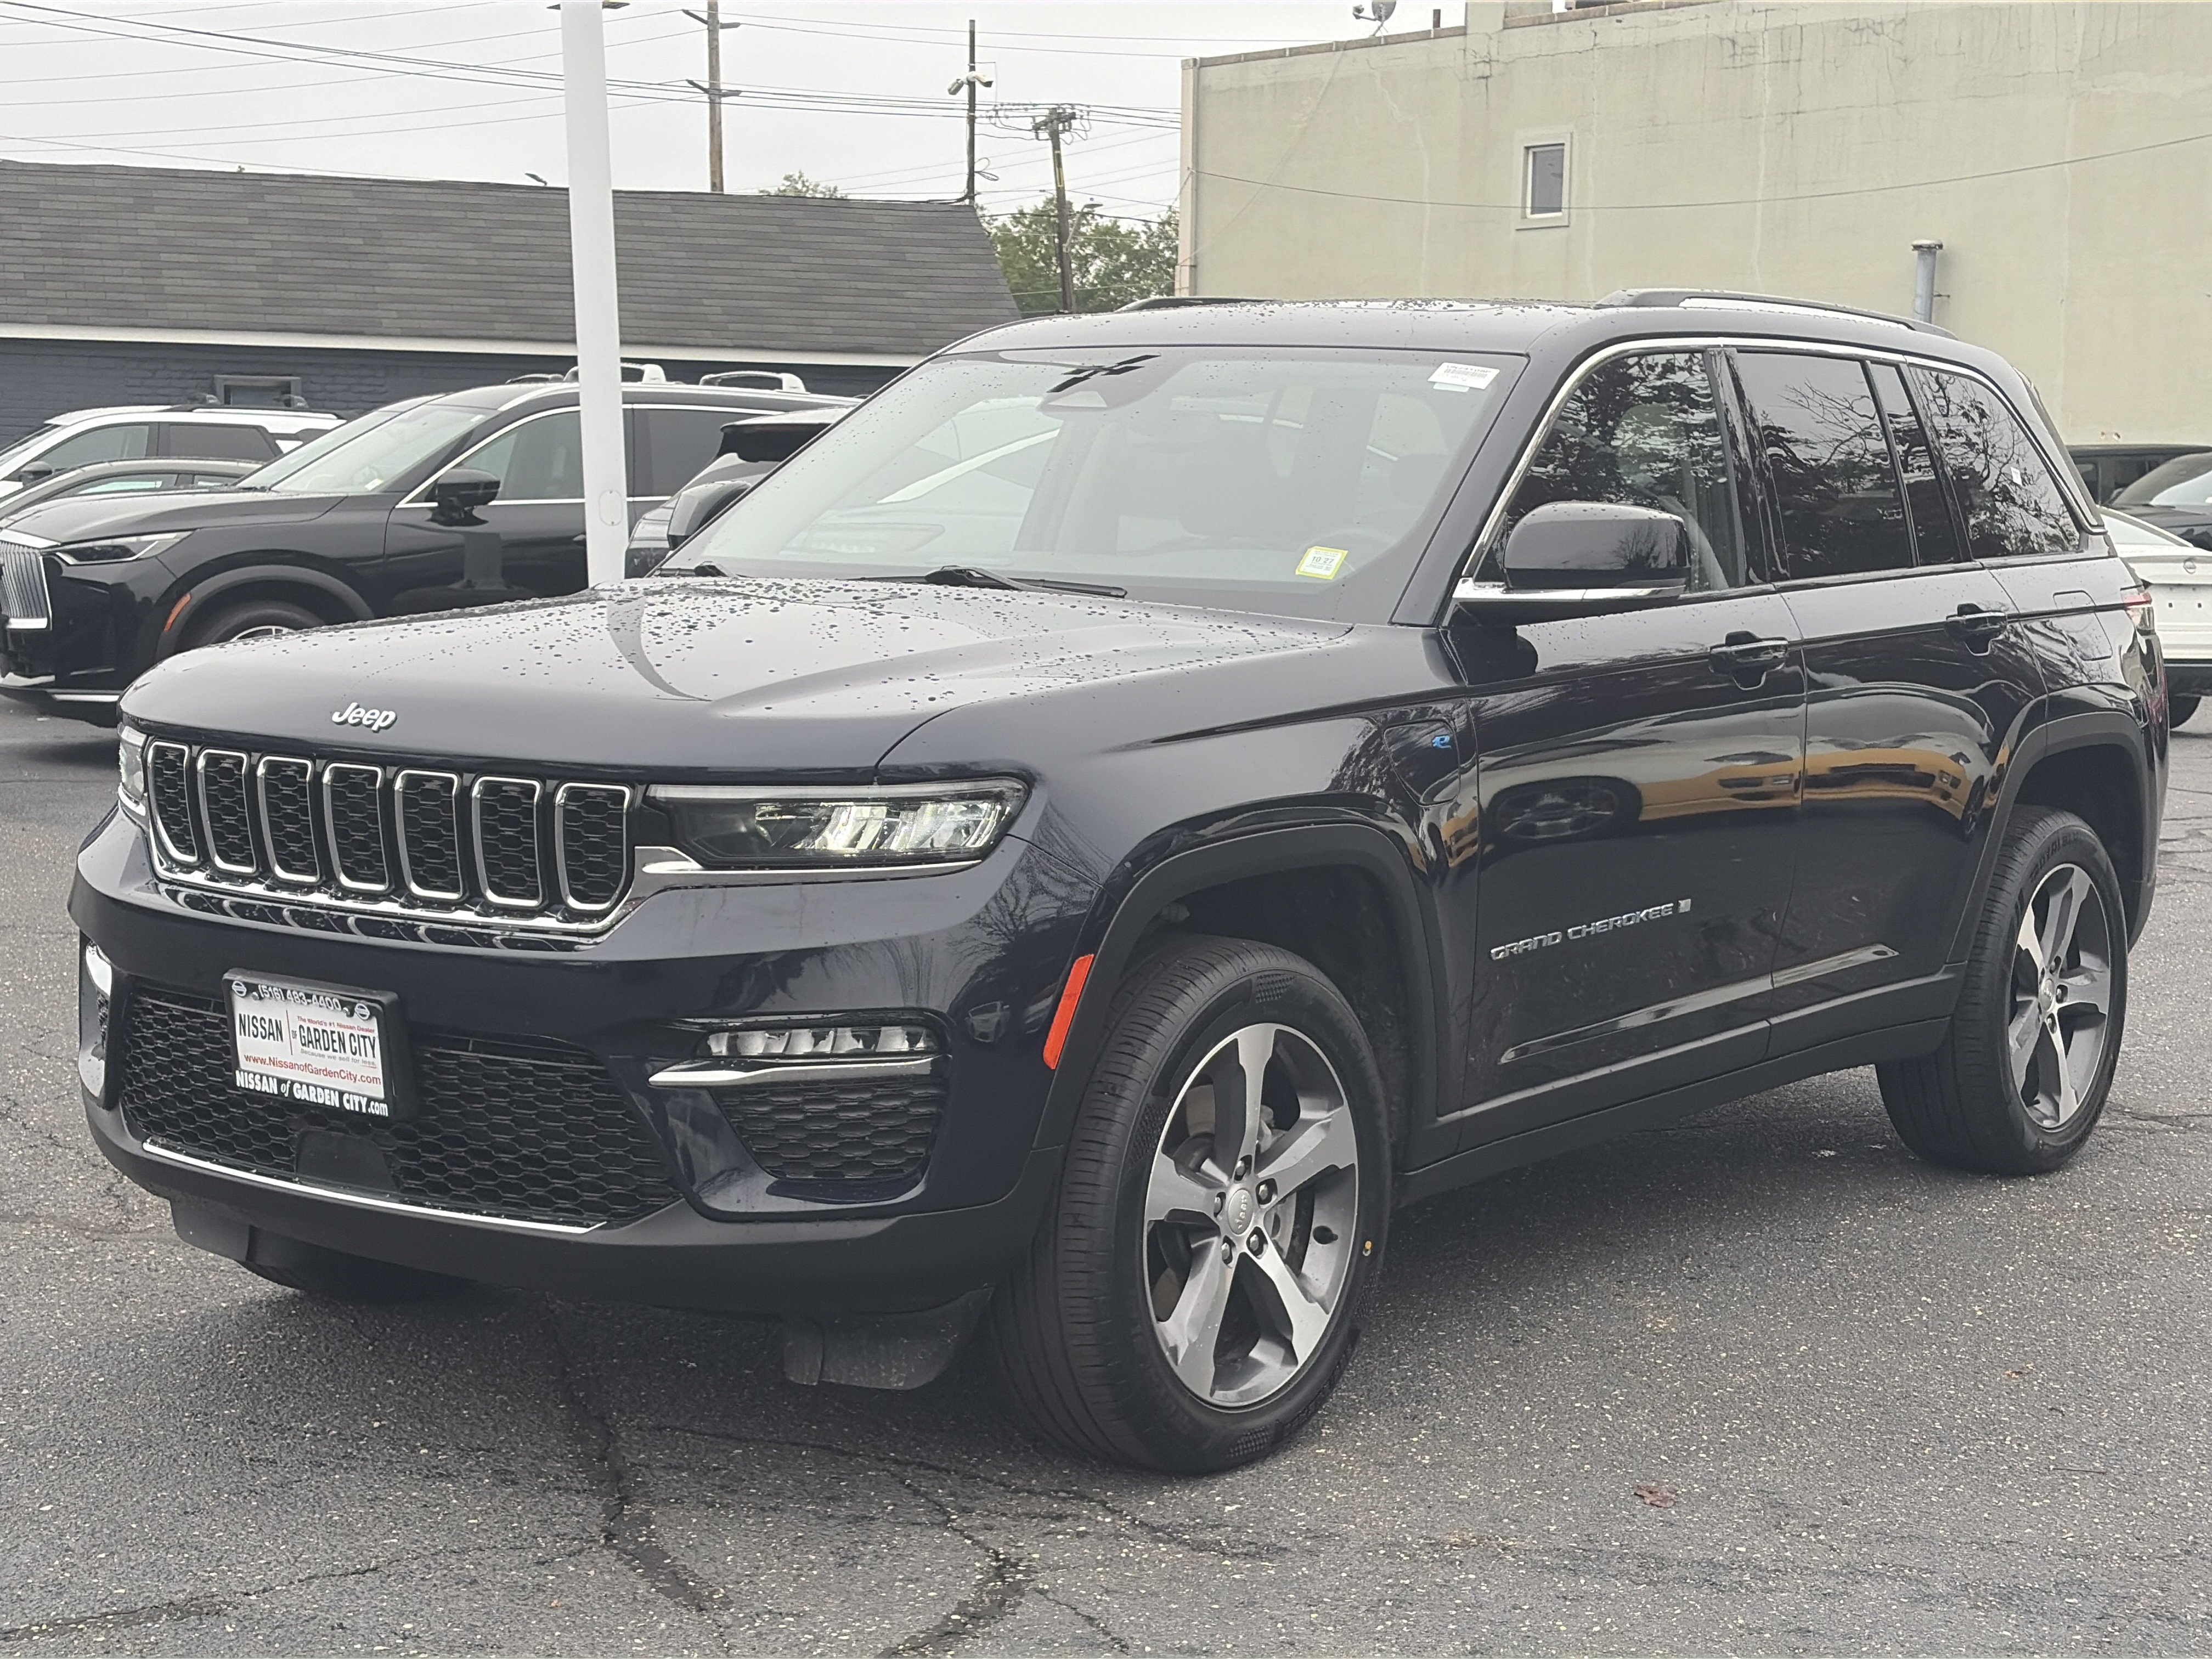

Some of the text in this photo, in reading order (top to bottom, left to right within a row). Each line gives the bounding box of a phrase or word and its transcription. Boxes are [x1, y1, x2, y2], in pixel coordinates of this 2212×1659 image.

[332, 702, 397, 733] Jeep
[1490, 902, 1673, 960] GRAND CHEROKEE
[258, 984, 341, 1011] (516) 483-4400
[239, 1013, 376, 1058] NISSAN OF GARDEN CITY
[301, 1048, 325, 1058] Because
[244, 1054, 381, 1085] www.NissanofGardenCity.com
[235, 1070, 278, 1094] NISSAN
[280, 1080, 291, 1097] of
[293, 1083, 340, 1108] GARDEN
